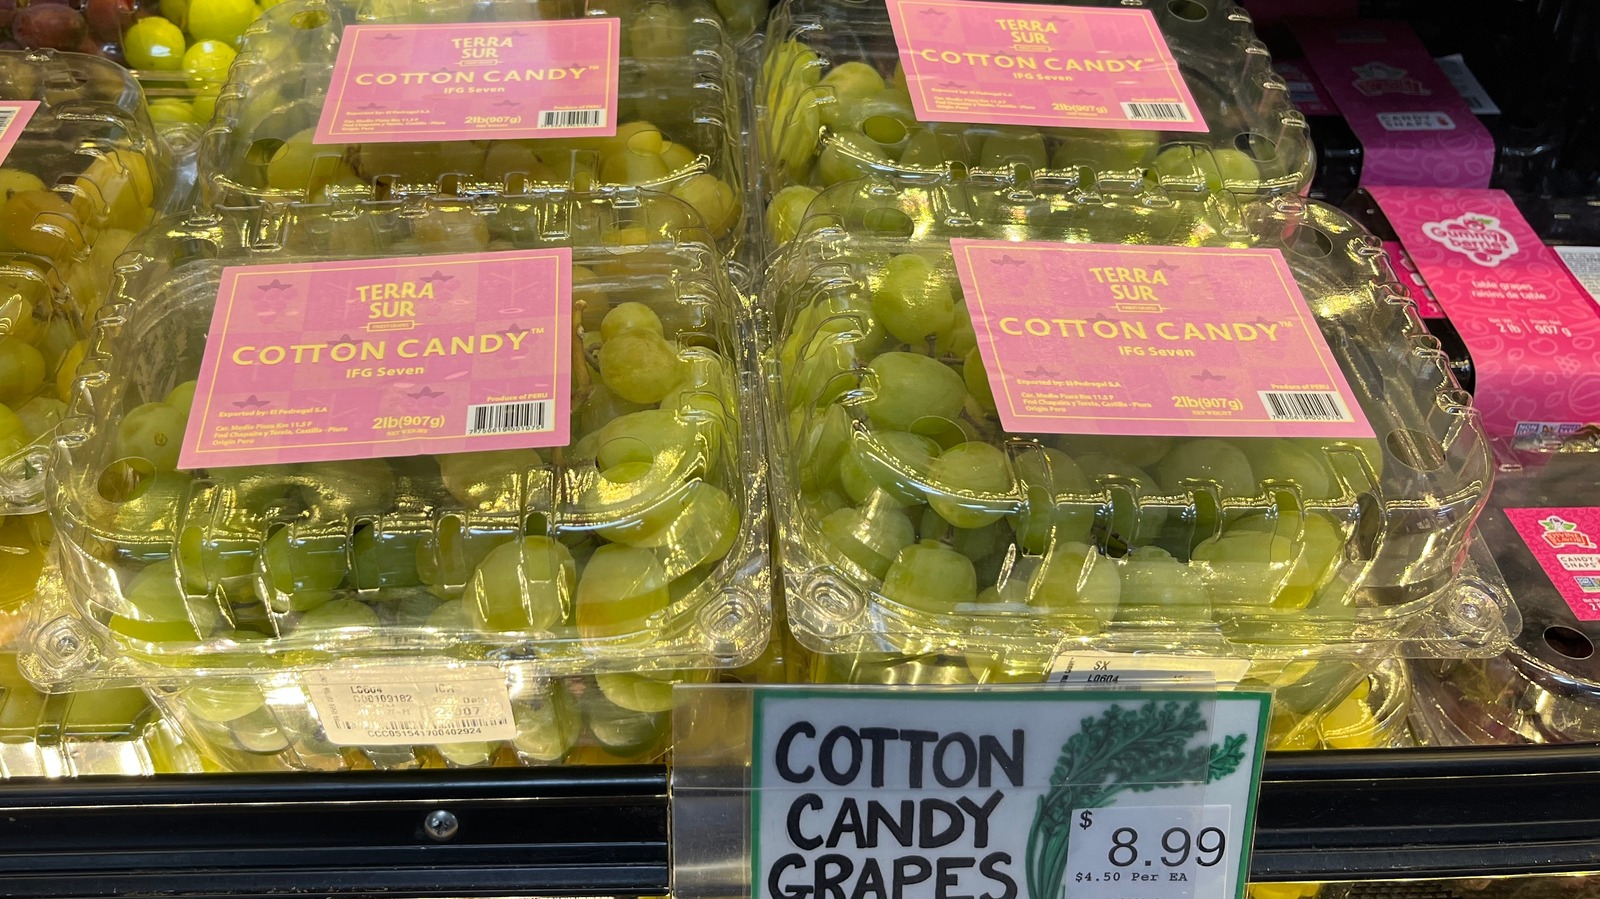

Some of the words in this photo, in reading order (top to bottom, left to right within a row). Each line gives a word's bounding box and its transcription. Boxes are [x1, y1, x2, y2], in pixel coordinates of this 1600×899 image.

[995, 18, 1058, 34] TERRA
[451, 36, 513, 49] TERRA
[1011, 31, 1049, 45] SUR
[461, 48, 499, 59] SUR
[921, 48, 1037, 70] COTTON
[355, 71, 474, 86] COTTON
[1013, 72, 1034, 80] IFG
[1036, 73, 1073, 81] Seven
[443, 87, 464, 95] IFG
[467, 86, 505, 94] Seven
[464, 116, 522, 124] 2lb(907g)
[1431, 226, 1501, 243] Gummy
[1448, 238, 1510, 251] berries
[1088, 266, 1169, 286] TERRA
[356, 281, 434, 303] TERRA
[1110, 284, 1159, 301] SUR
[1471, 279, 1498, 289] table
[1499, 282, 1533, 292] grapes
[1471, 289, 1505, 299] raisins
[1506, 291, 1520, 300] de
[1519, 291, 1547, 300] table
[368, 300, 416, 319] SUR
[999, 317, 1148, 340] COTTON
[1496, 322, 1507, 333] 2
[1507, 323, 1522, 334] lb
[1534, 324, 1558, 335] 907
[1561, 327, 1572, 338] g
[231, 341, 385, 366] COTTON
[1118, 345, 1145, 356] IFG
[1148, 346, 1196, 358] Seven
[346, 366, 373, 379] IFG
[376, 365, 424, 377] Seven
[1172, 395, 1244, 411] 2lb(907g)
[218, 410, 254, 418] Exported
[256, 409, 269, 417] by:
[278, 407, 314, 416] Pedregal
[372, 415, 445, 430] 2lb(907g)
[1093, 660, 1111, 671] SX
[775, 721, 1025, 788] COTTON
[786, 789, 1004, 850] CANDY
[1079, 809, 1093, 830] $
[1108, 826, 1226, 867] 8.99
[768, 852, 1018, 899] GRAPES
[1075, 871, 1121, 883] $4.50
[1131, 871, 1160, 882] Per
[1168, 872, 1188, 882] EA
